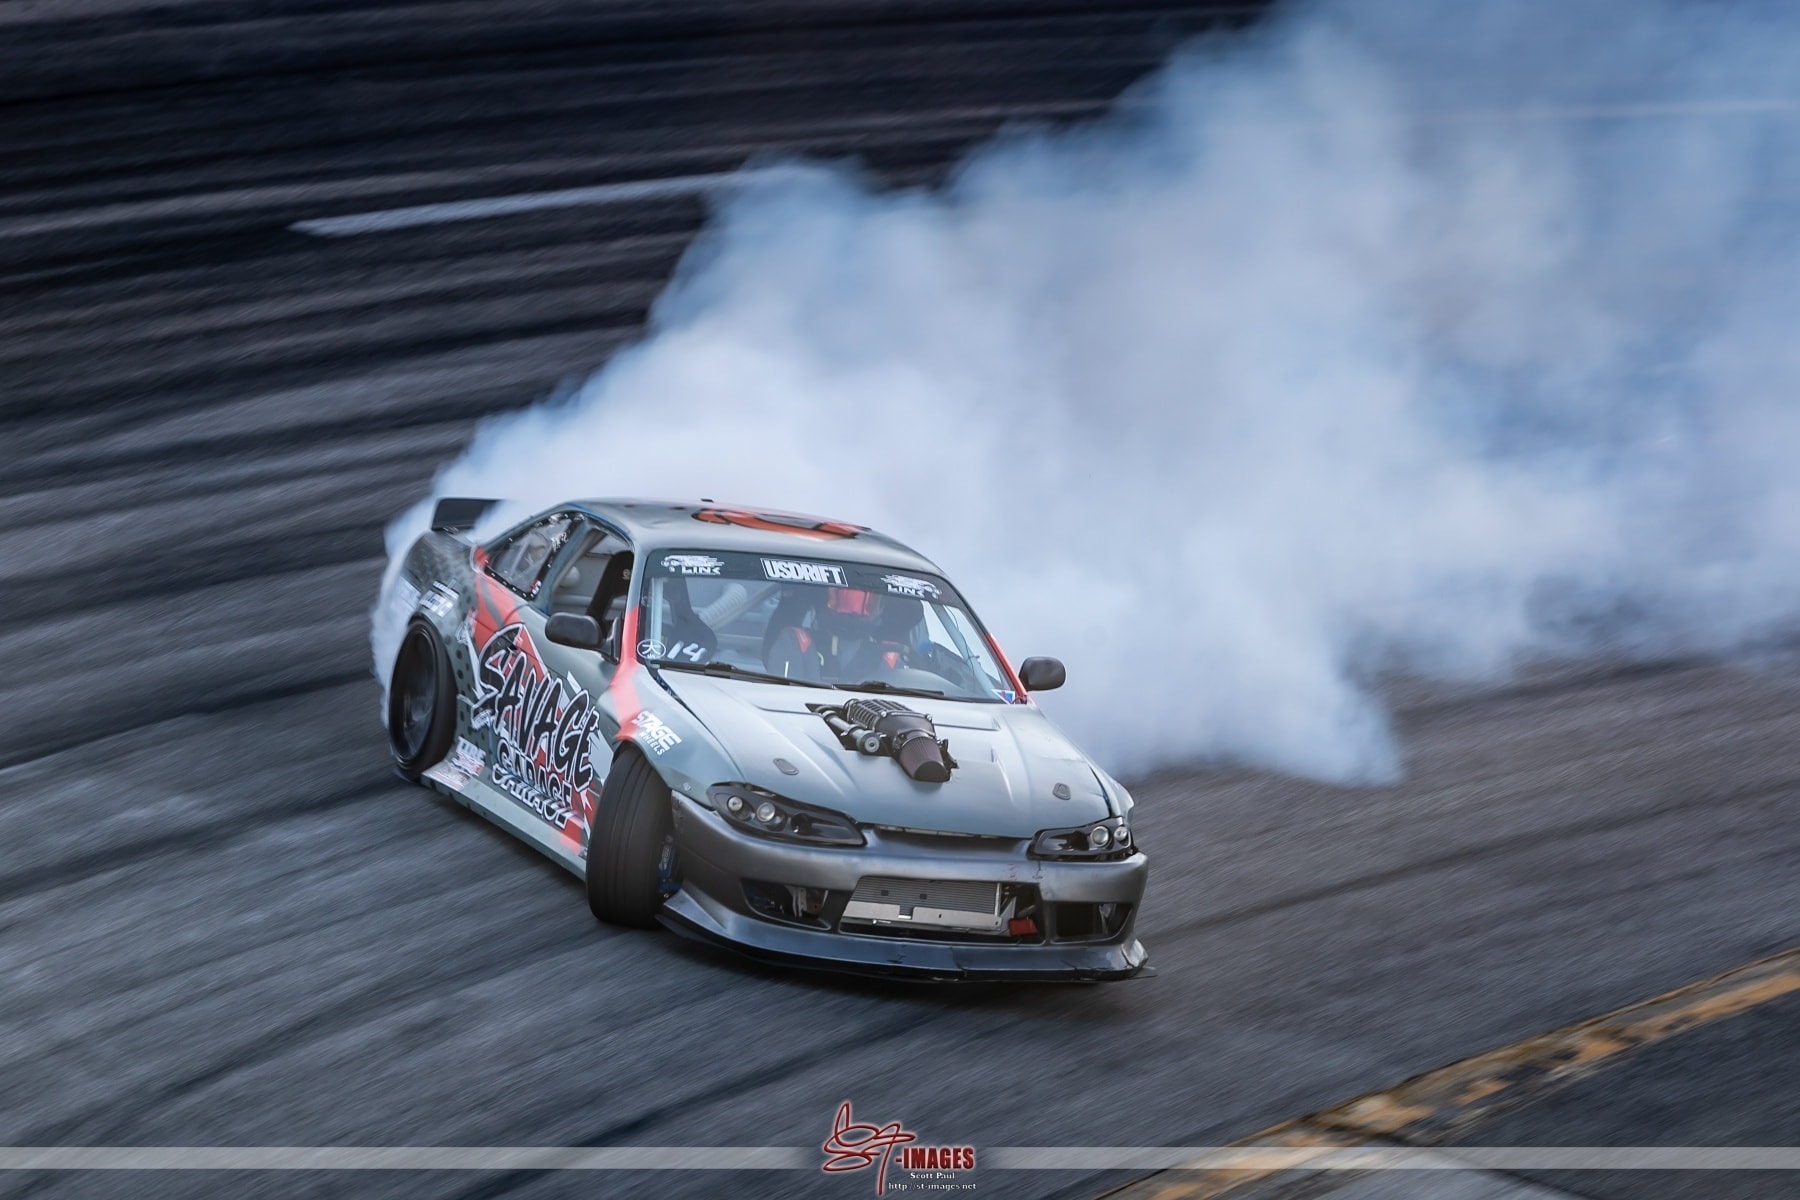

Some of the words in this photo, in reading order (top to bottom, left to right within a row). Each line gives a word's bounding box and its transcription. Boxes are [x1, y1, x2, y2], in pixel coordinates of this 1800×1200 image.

[763, 560, 842, 584] USDRIFT
[667, 640, 707, 662] 14
[471, 623, 600, 793] SAVAGE
